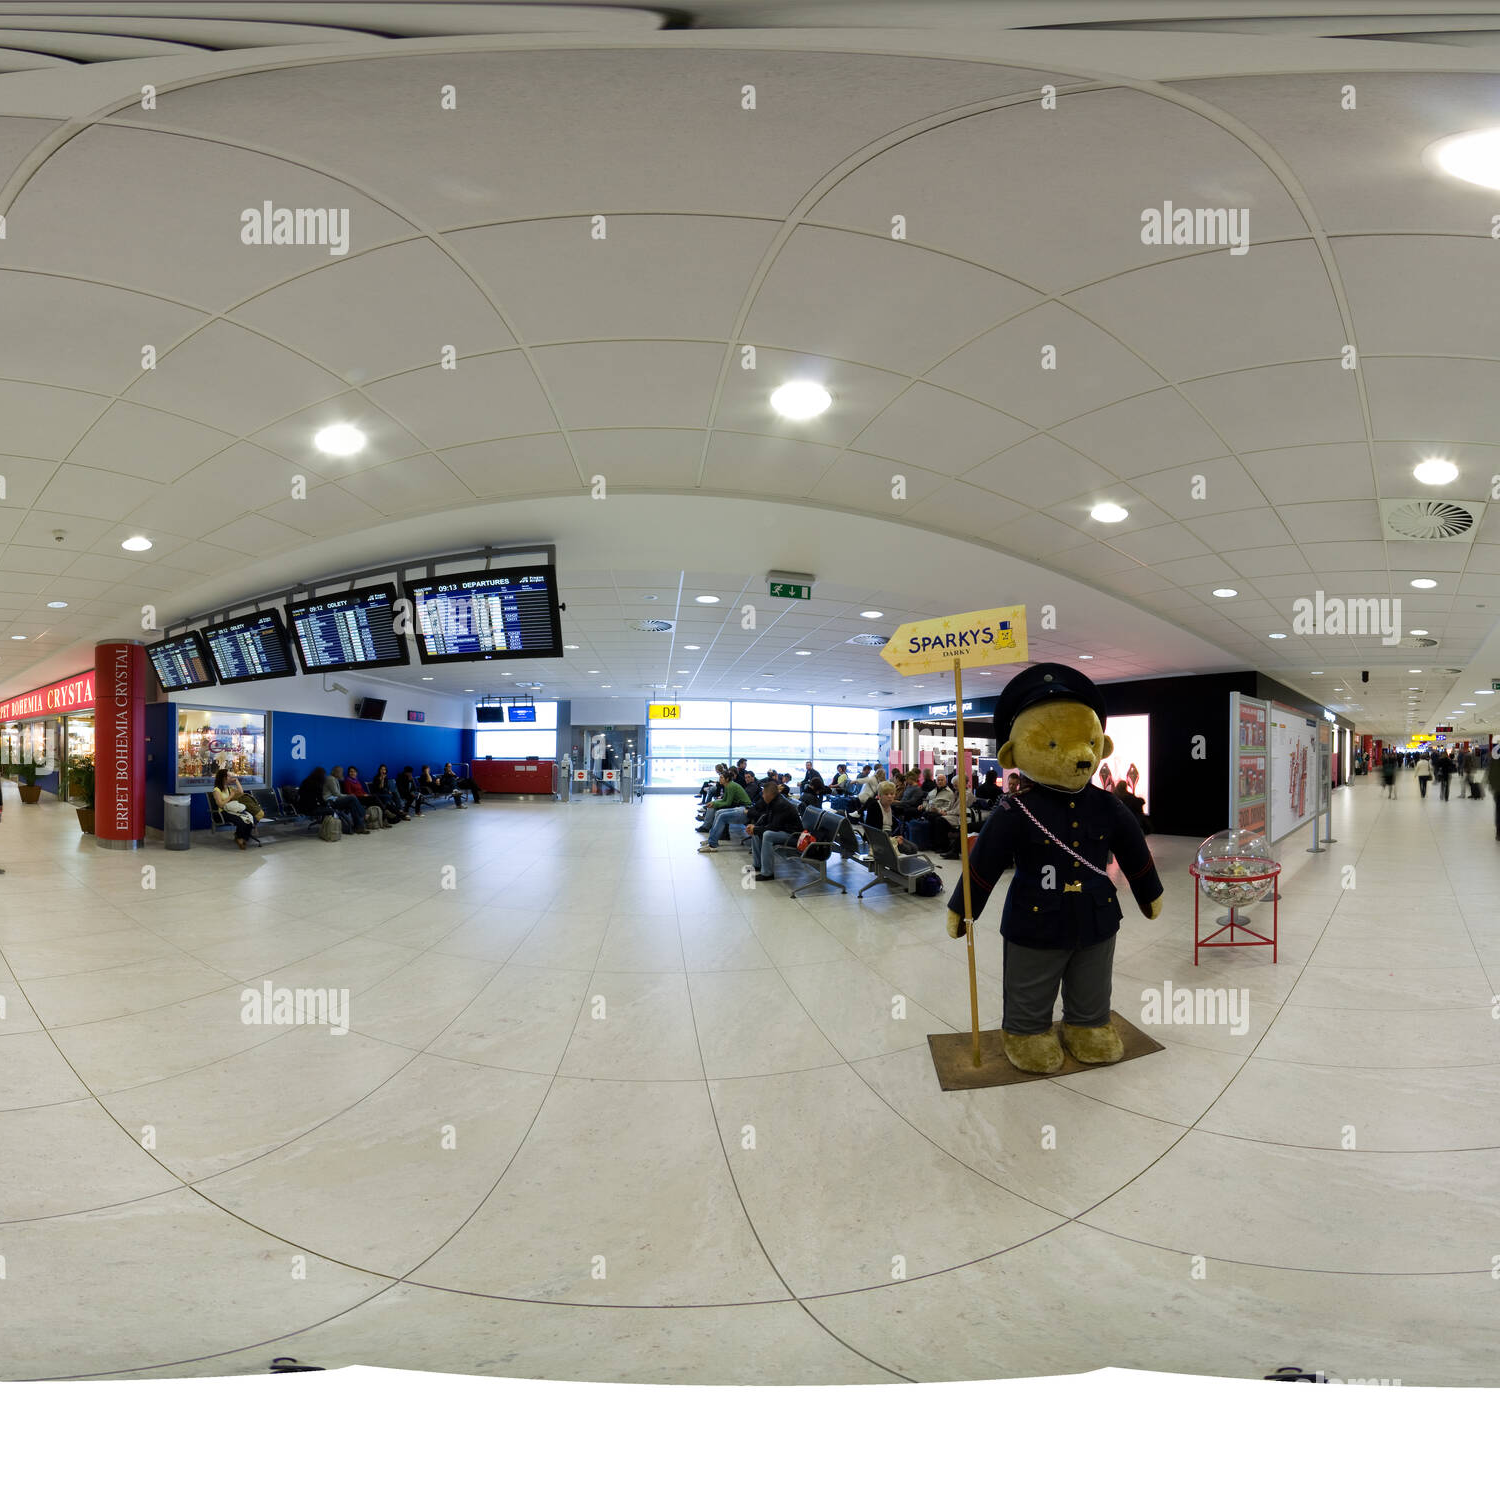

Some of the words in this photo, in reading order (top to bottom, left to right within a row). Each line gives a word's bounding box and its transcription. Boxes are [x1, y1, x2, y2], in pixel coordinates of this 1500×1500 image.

[438, 584, 458, 592] 09:13
[462, 578, 510, 589] DEPARTURES
[909, 627, 994, 653] SPARKYS
[942, 648, 971, 657] DARKY
[115, 645, 129, 708] CRYSTAL
[11, 694, 43, 718] BOHEMIA
[47, 679, 96, 709] CRYSTA
[663, 707, 676, 718] D4
[116, 710, 128, 781] BOHEMIA
[116, 786, 129, 831] ERPET
